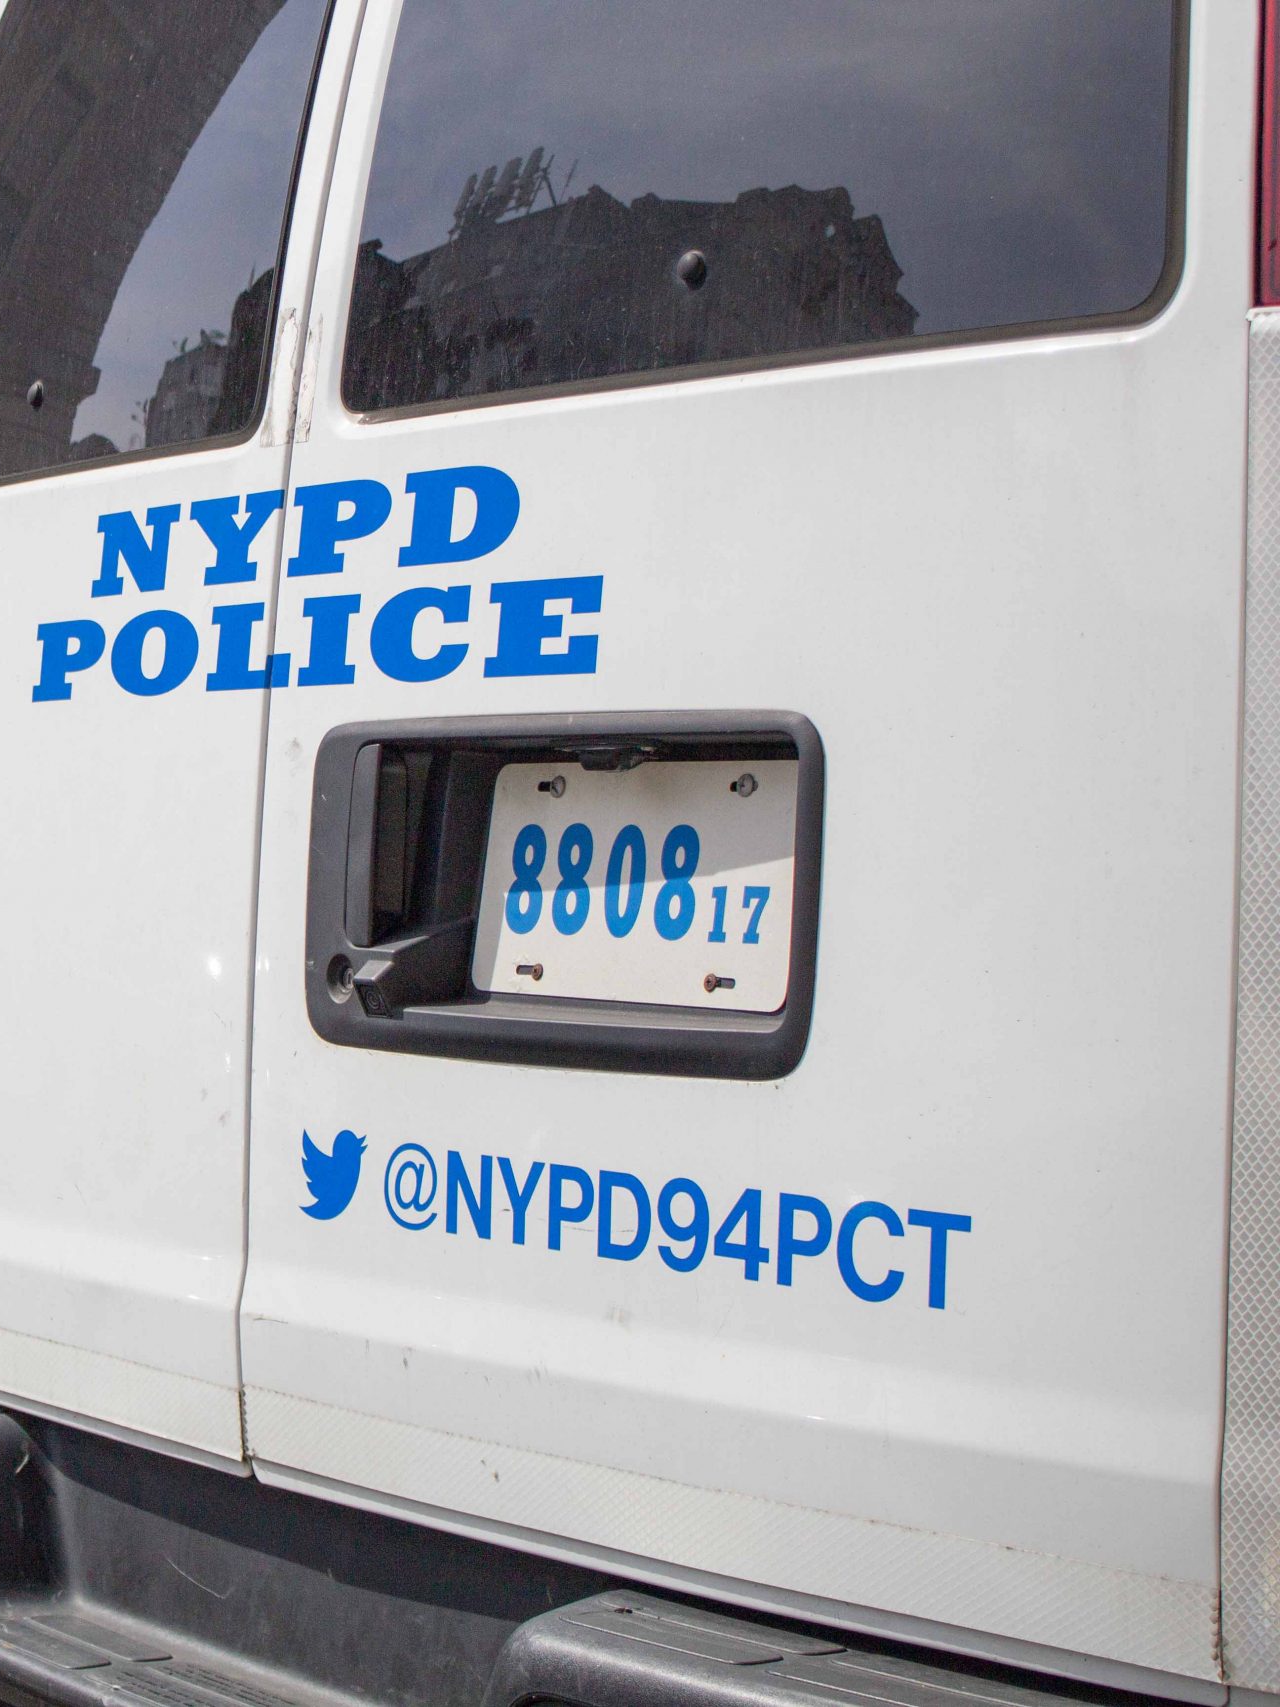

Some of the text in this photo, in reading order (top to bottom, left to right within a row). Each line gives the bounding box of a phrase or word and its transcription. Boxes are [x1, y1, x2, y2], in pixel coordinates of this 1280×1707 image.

[91, 465, 521, 599] NYPD
[32, 574, 605, 703] POLICE
[505, 823, 771, 945] 8808 17
[383, 1142, 973, 1311] @NYPD94PCT
